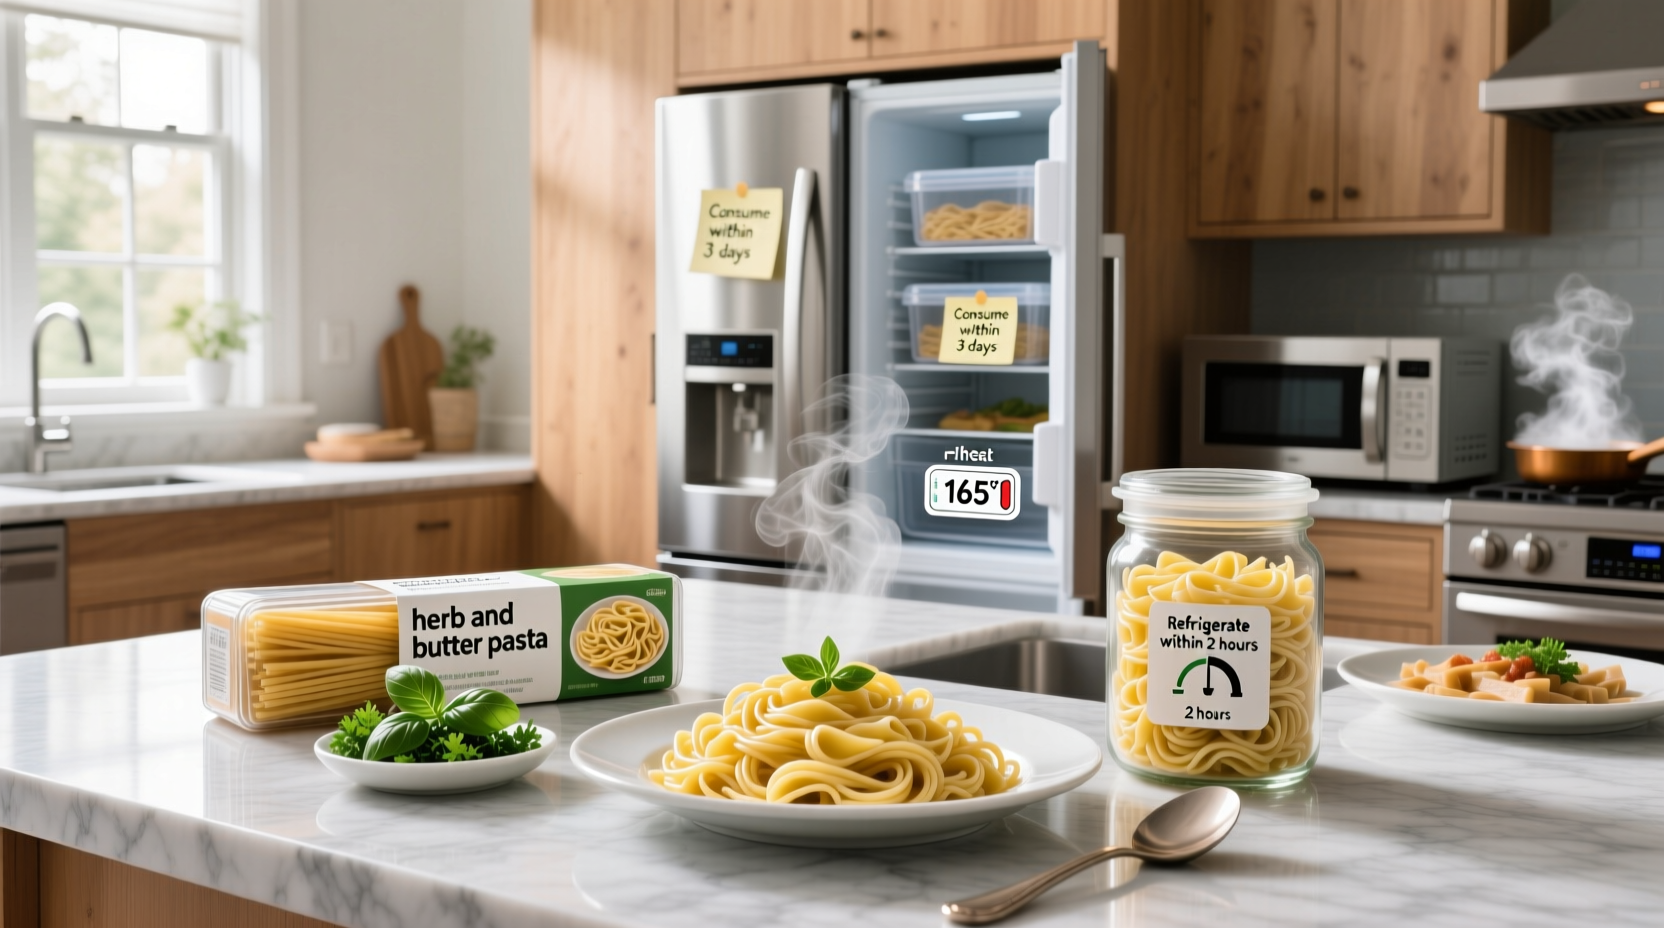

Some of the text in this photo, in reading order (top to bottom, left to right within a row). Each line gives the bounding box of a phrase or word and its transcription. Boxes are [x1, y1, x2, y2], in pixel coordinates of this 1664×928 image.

[710, 223, 753, 238] within
[703, 241, 751, 265] 3 days
[954, 307, 1009, 320] Consume
[956, 338, 998, 357] 3 days
[412, 601, 514, 631] herb and
[1167, 615, 1250, 636] Refrigerate
[412, 628, 549, 660] butter pasta
[1160, 634, 1259, 652] within 2 hours
[1184, 706, 1231, 720] 2 hours
